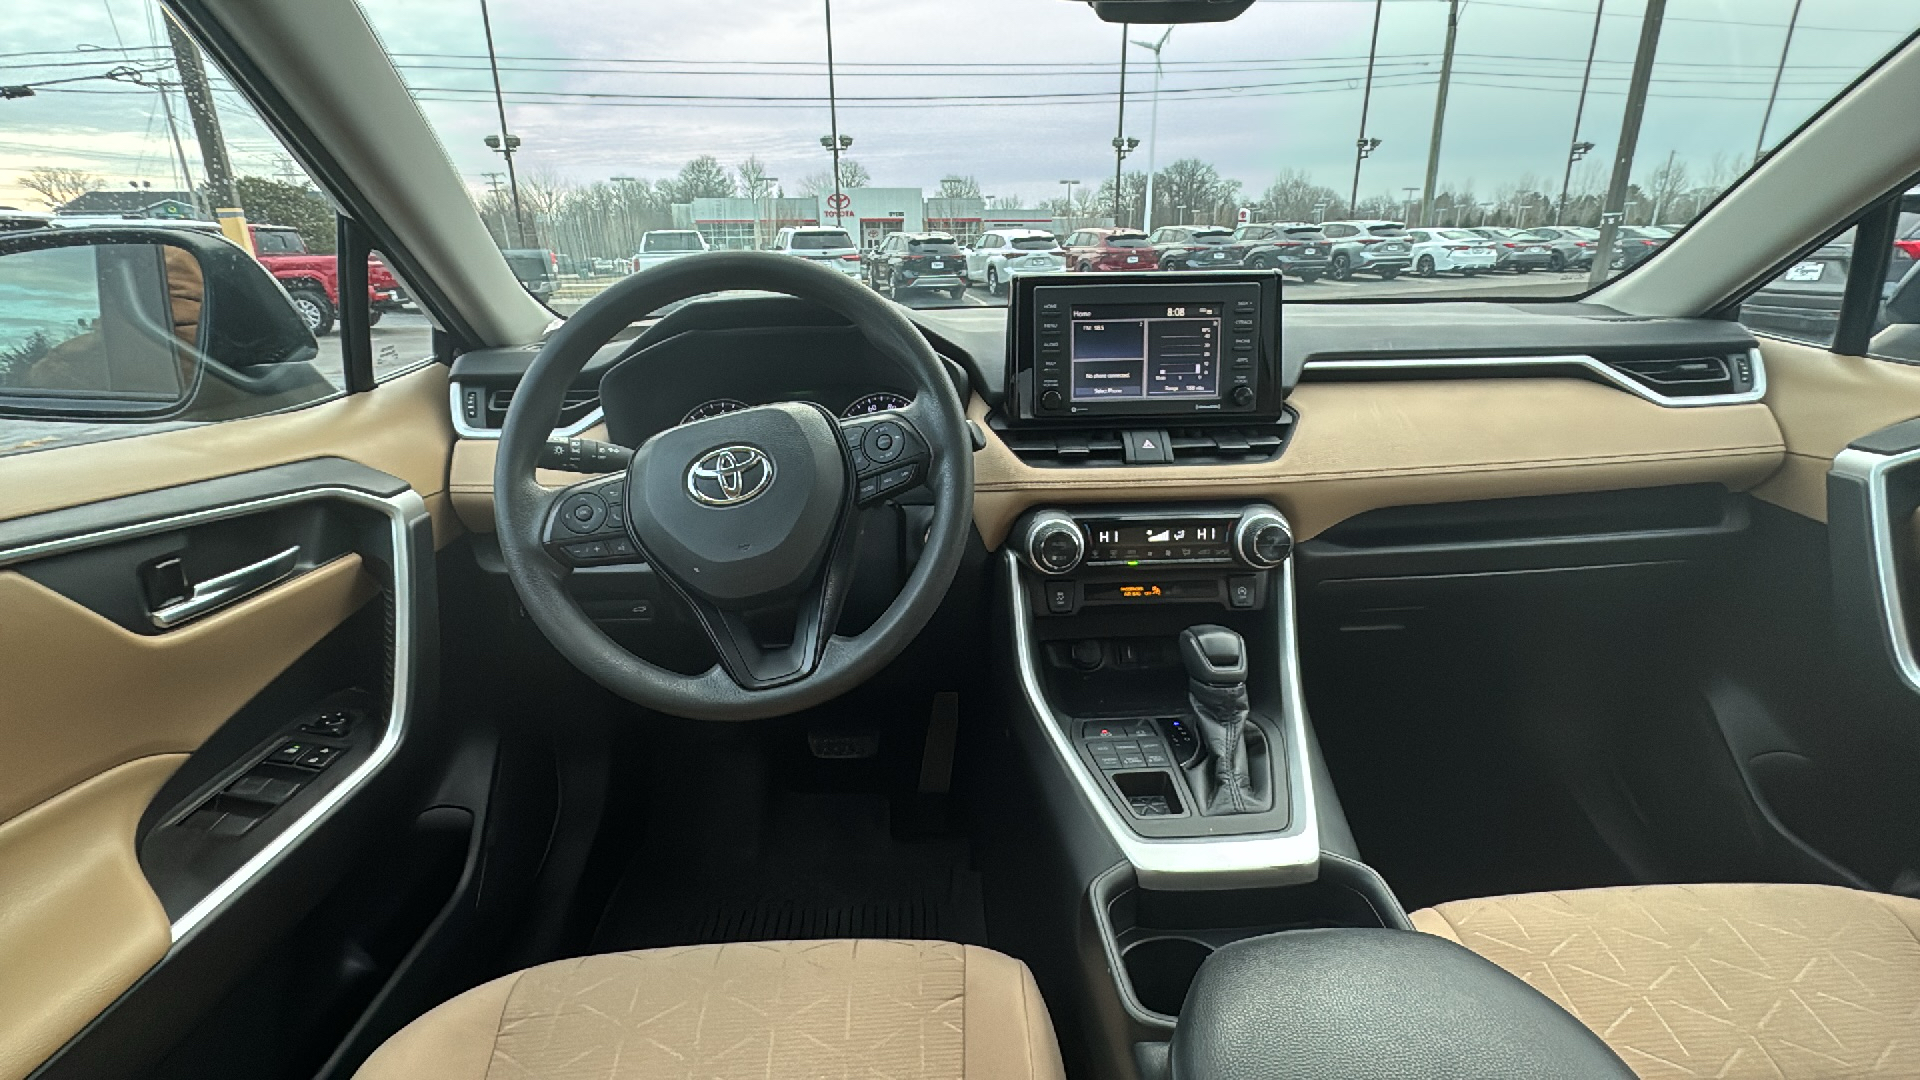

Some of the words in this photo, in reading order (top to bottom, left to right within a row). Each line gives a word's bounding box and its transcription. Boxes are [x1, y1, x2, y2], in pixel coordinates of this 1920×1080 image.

[1073, 310, 1092, 318] Home
[1167, 307, 1184, 317] 8:08
[867, 404, 877, 413] 60
